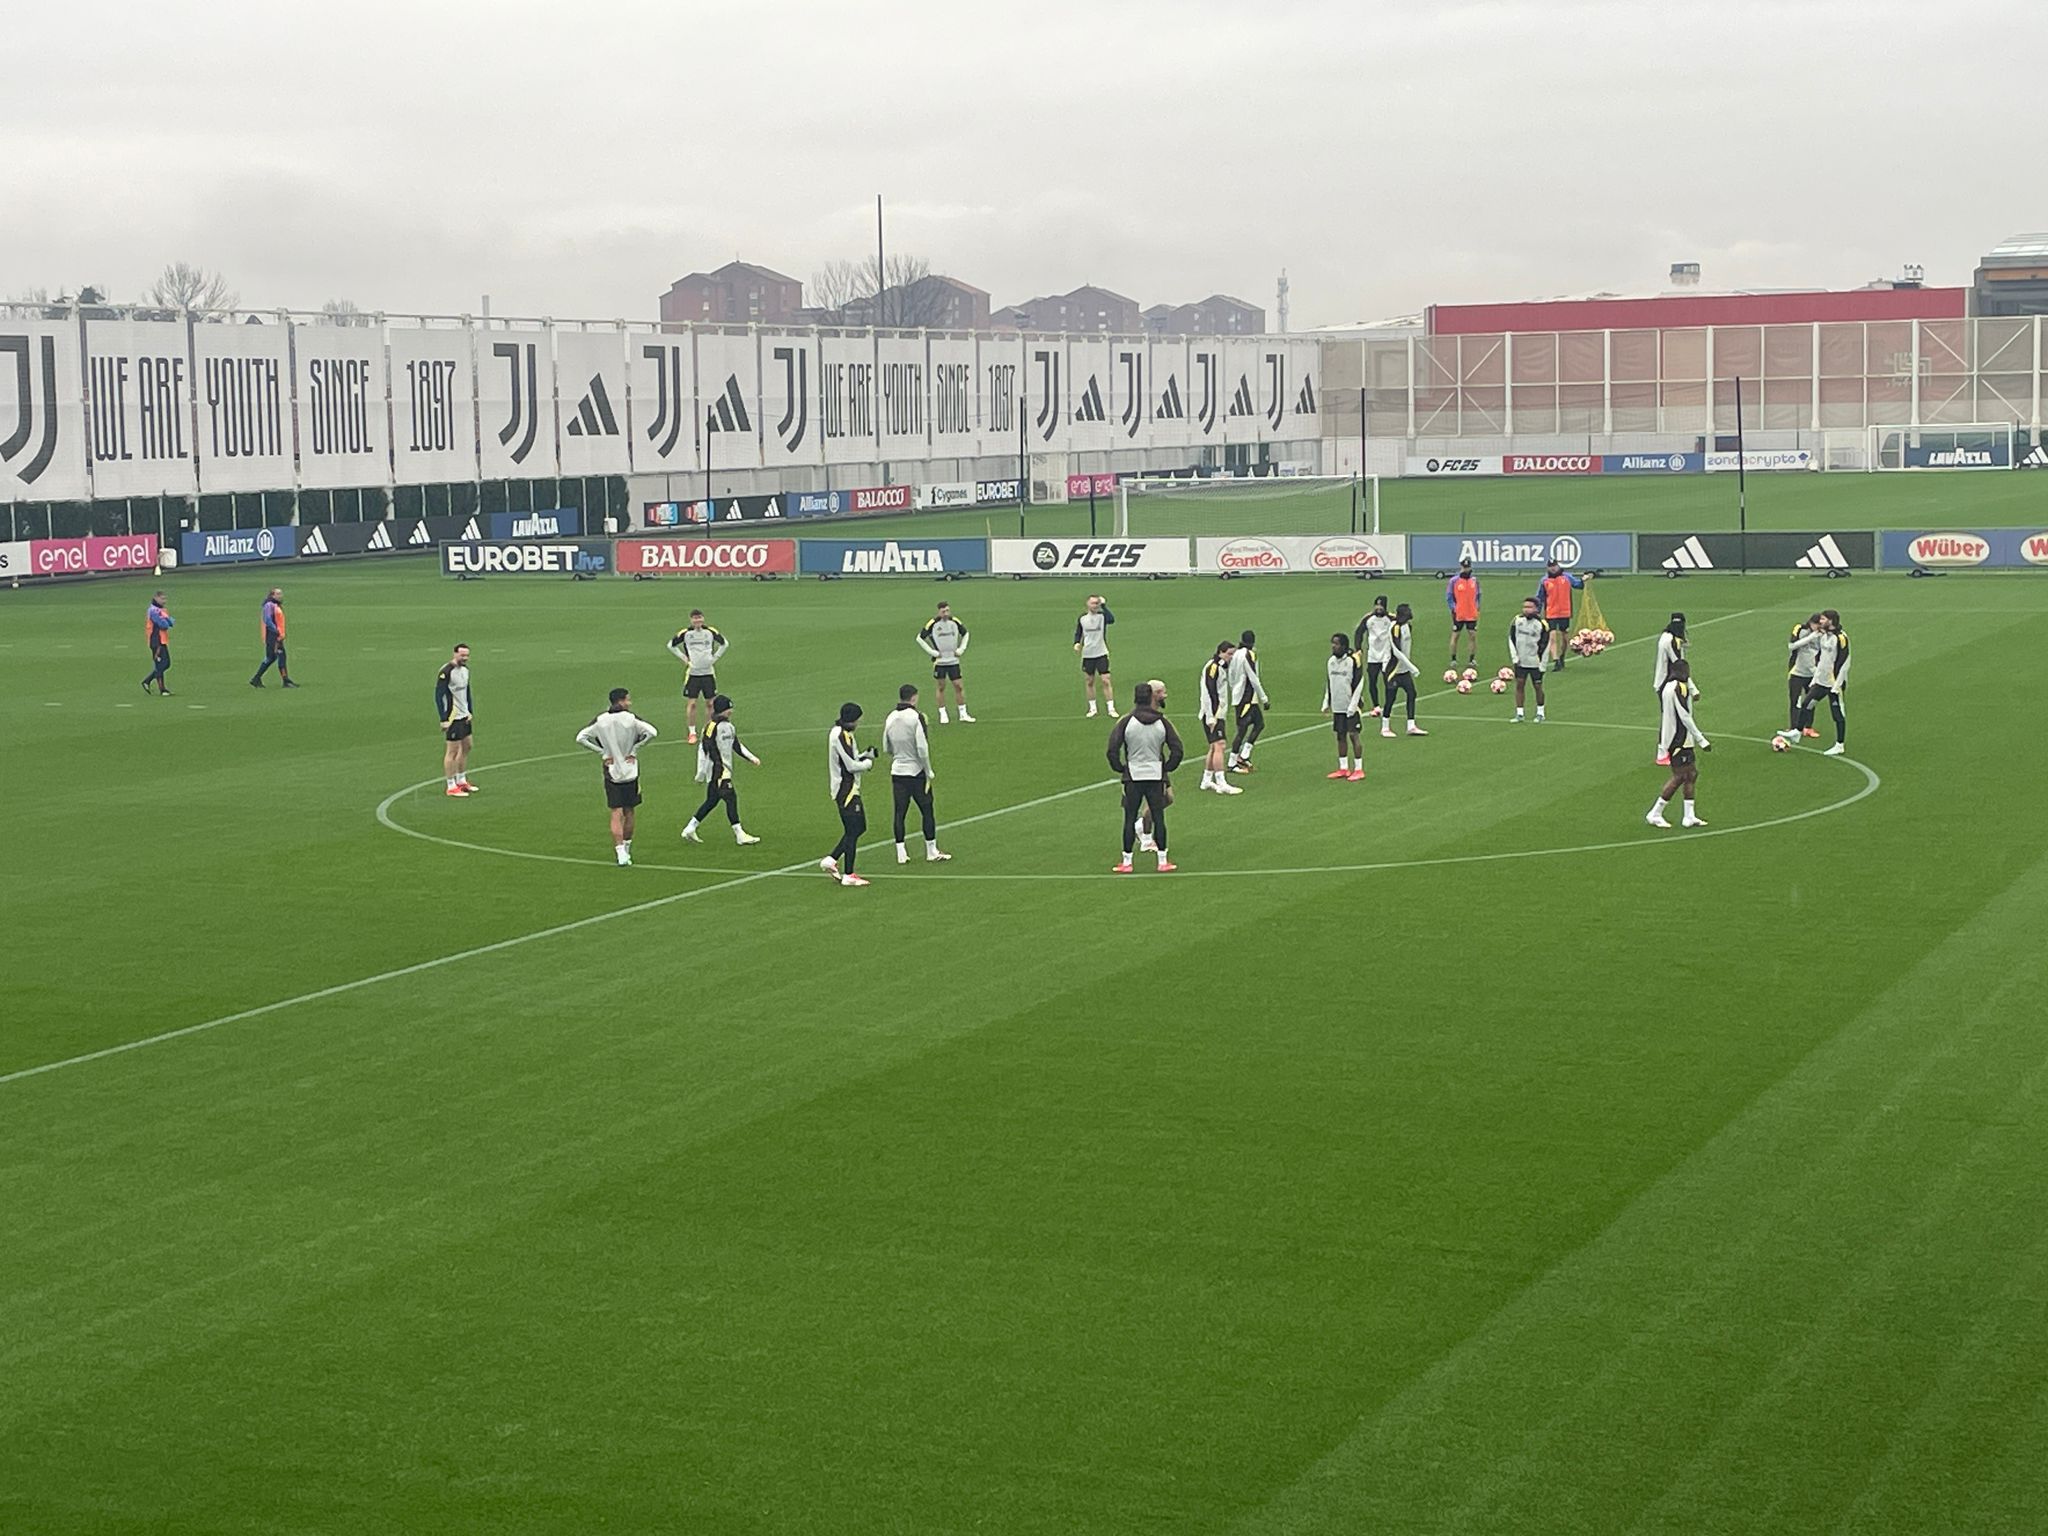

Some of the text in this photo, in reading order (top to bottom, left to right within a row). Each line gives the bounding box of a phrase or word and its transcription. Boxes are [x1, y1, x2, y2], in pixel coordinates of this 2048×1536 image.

[91, 356, 188, 461] WE ARE
[205, 358, 282, 458] YOUTH
[310, 359, 373, 455] SINCE
[406, 360, 456, 452] 1897
[824, 363, 873, 438] WE ARE
[883, 363, 923, 436] YOUTH
[937, 363, 970, 434] SINCE
[988, 364, 1015, 432] 1897
[1512, 457, 1591, 471] BALOCCO
[1622, 457, 1666, 469] Allianz
[1928, 447, 1992, 465] LAVAZZA
[857, 488, 905, 508] BALOCCO
[977, 481, 1020, 500] EUROBET
[512, 512, 559, 537] LAVAZZA
[39, 540, 89, 570] enel
[103, 538, 151, 567] enel
[205, 535, 254, 557] Allianz
[640, 544, 769, 568] BALOCCO
[842, 541, 944, 573] LAVAZZA
[1459, 539, 1545, 562] Allianz
[1917, 538, 1985, 558] Wüber
